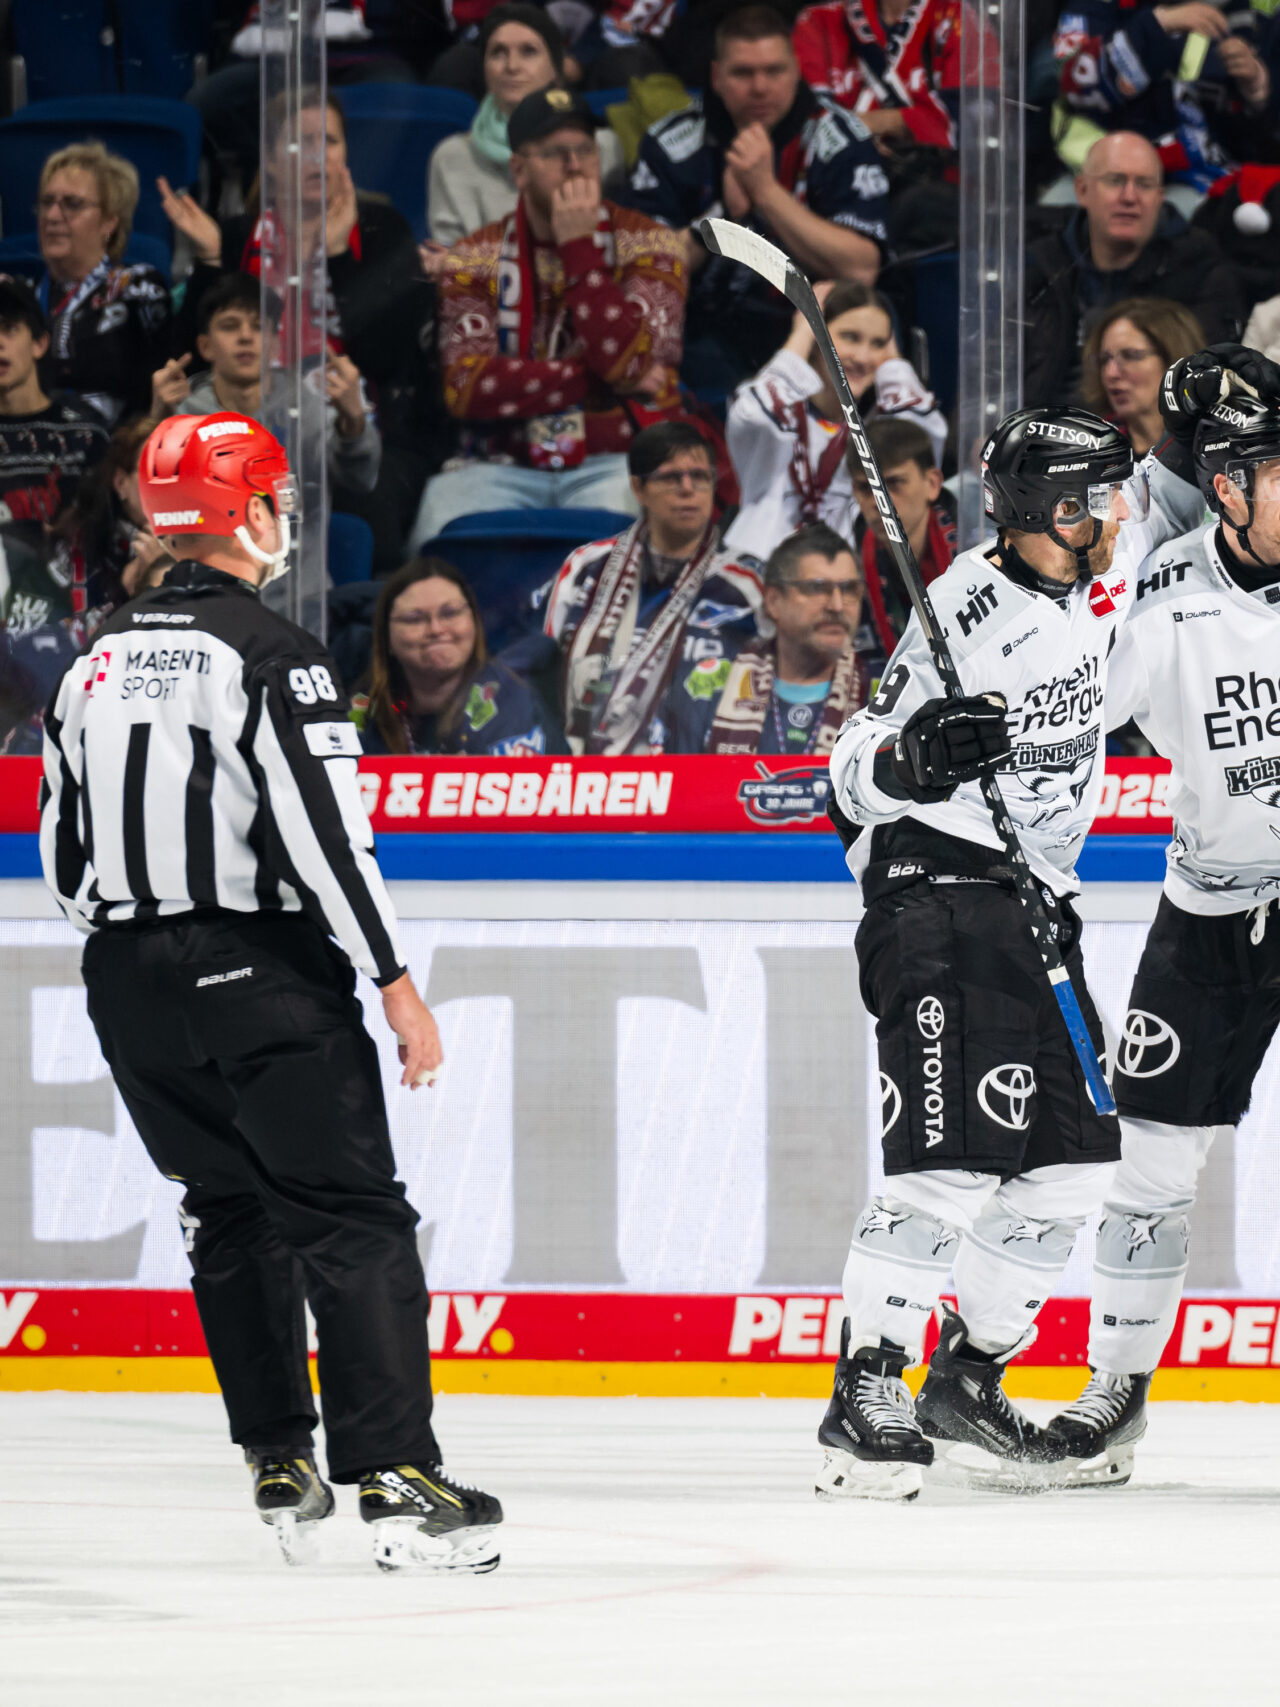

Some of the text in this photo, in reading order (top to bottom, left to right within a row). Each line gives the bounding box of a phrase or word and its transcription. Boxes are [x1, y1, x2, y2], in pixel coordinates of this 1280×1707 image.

[1026, 421, 1101, 451] STETSON
[1204, 441, 1232, 452] BAUER
[841, 404, 903, 543] BAUER
[1047, 462, 1089, 474] BAUER
[1136, 559, 1193, 601] HIT
[955, 583, 999, 638] HIT
[288, 664, 339, 705] 98
[428, 762, 673, 817] EISBÄREN
[196, 966, 253, 987] BAUER
[923, 1041, 944, 1149] TOYOTA
[841, 1418, 862, 1444] BAUER
